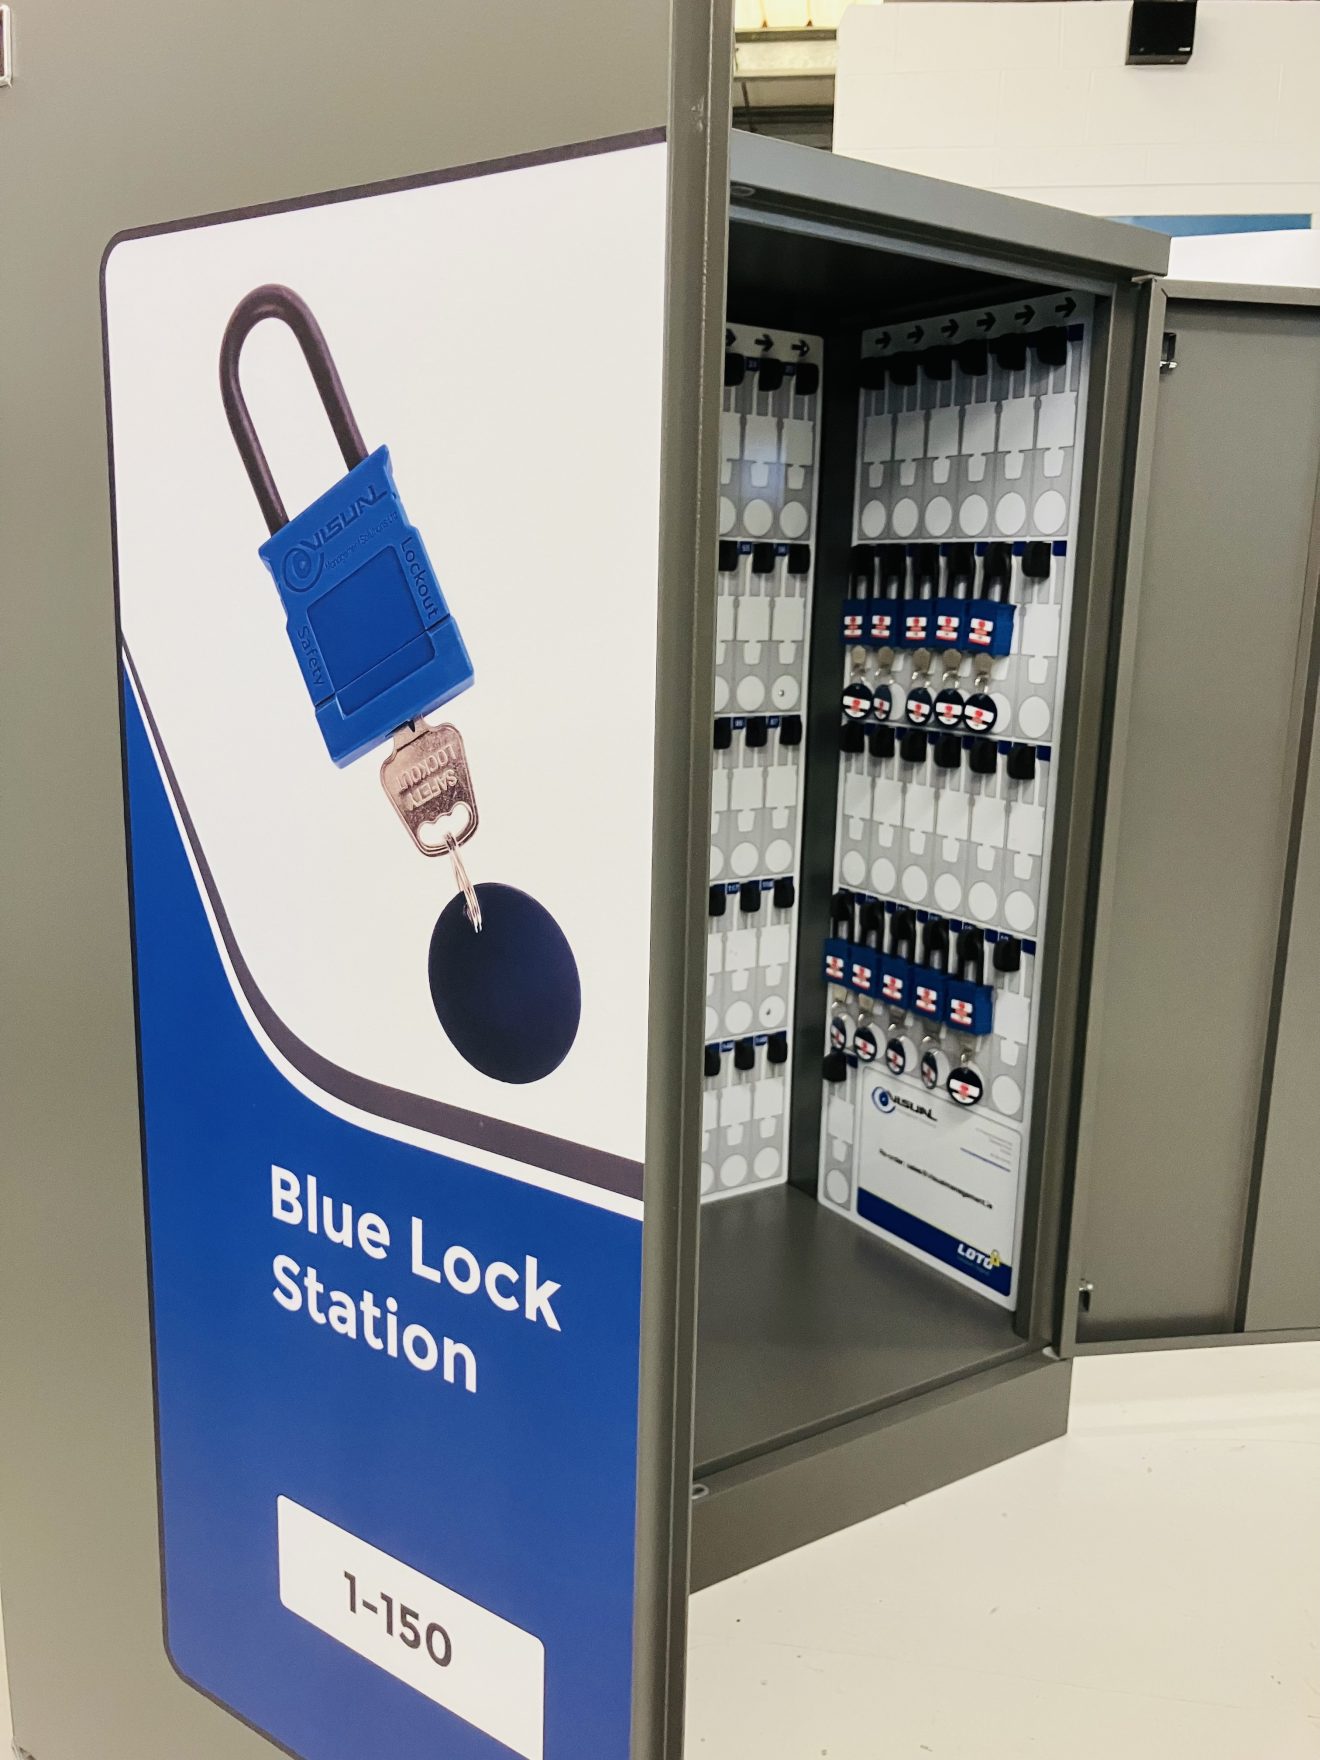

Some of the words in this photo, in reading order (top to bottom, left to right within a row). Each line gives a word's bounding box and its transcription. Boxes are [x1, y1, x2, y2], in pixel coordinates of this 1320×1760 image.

[300, 484, 388, 551] VISUAL
[401, 536, 438, 620] Lockout
[298, 624, 324, 686] Safety
[396, 744, 457, 791] LOCKOUT
[271, 1164, 390, 1260] Blue
[411, 1216, 562, 1332] Lock
[272, 1254, 477, 1394] Station
[344, 1570, 452, 1668] 1-150
